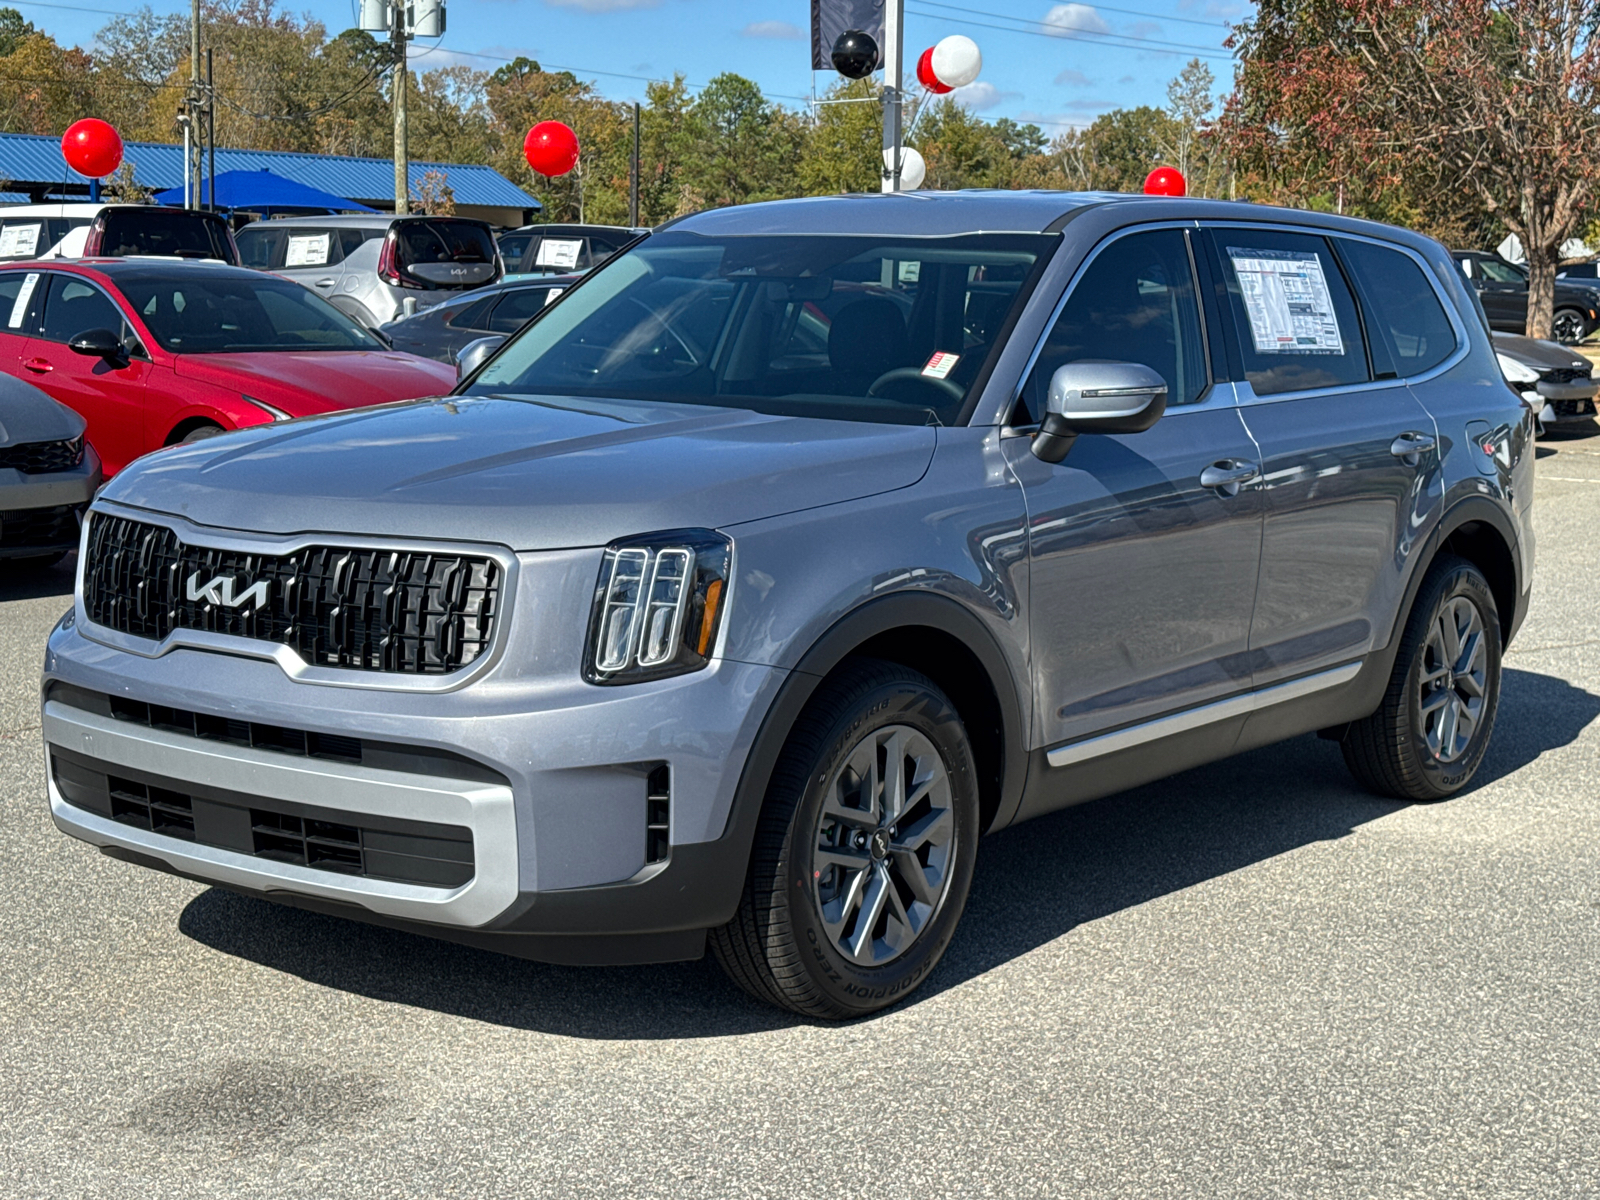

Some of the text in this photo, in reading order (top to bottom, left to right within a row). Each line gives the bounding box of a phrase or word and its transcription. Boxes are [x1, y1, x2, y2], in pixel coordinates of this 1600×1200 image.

[187, 570, 271, 610] KIA
[864, 697, 892, 721] R18
[1441, 770, 1466, 784] ZERO
[806, 927, 932, 1000] SCORPION ZERO
